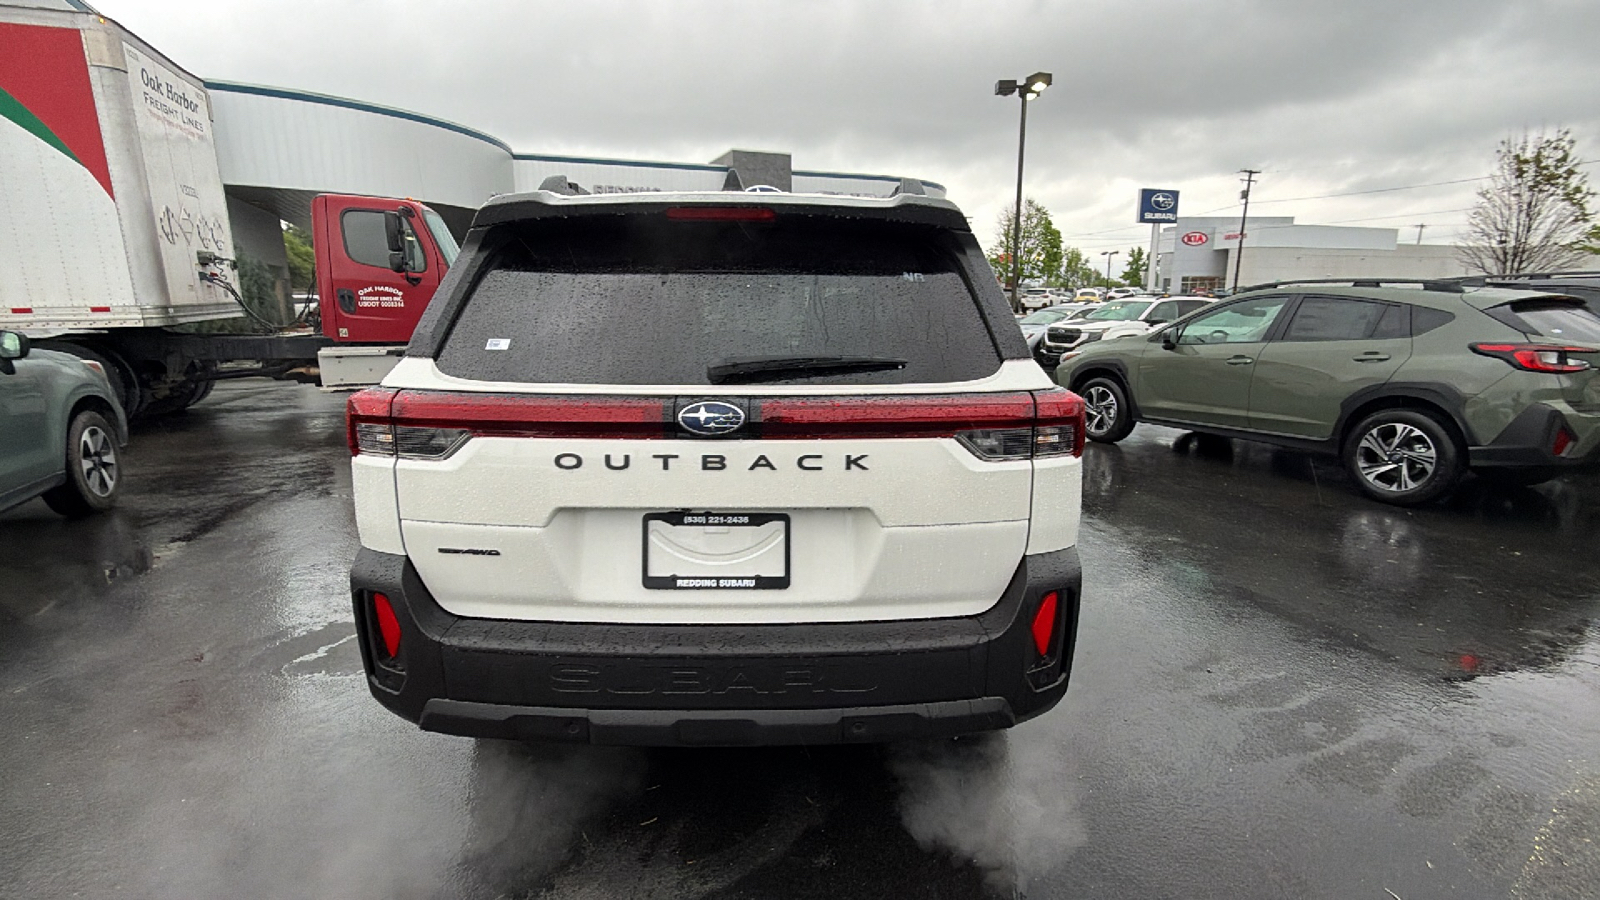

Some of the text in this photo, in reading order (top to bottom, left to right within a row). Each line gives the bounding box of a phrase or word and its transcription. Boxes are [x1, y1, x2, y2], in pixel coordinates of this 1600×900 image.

[141, 67, 199, 114] Oak Harbor
[143, 91, 179, 120] FREIGHT
[181, 111, 204, 132] LINES
[1144, 212, 1176, 220] SUBARU
[358, 286, 403, 296] OAK HARBOR
[554, 453, 869, 471] OUTBACK
[683, 515, 706, 524] (530)
[676, 579, 756, 587] REDDING SUBARU
[551, 663, 879, 695] SUBARU
